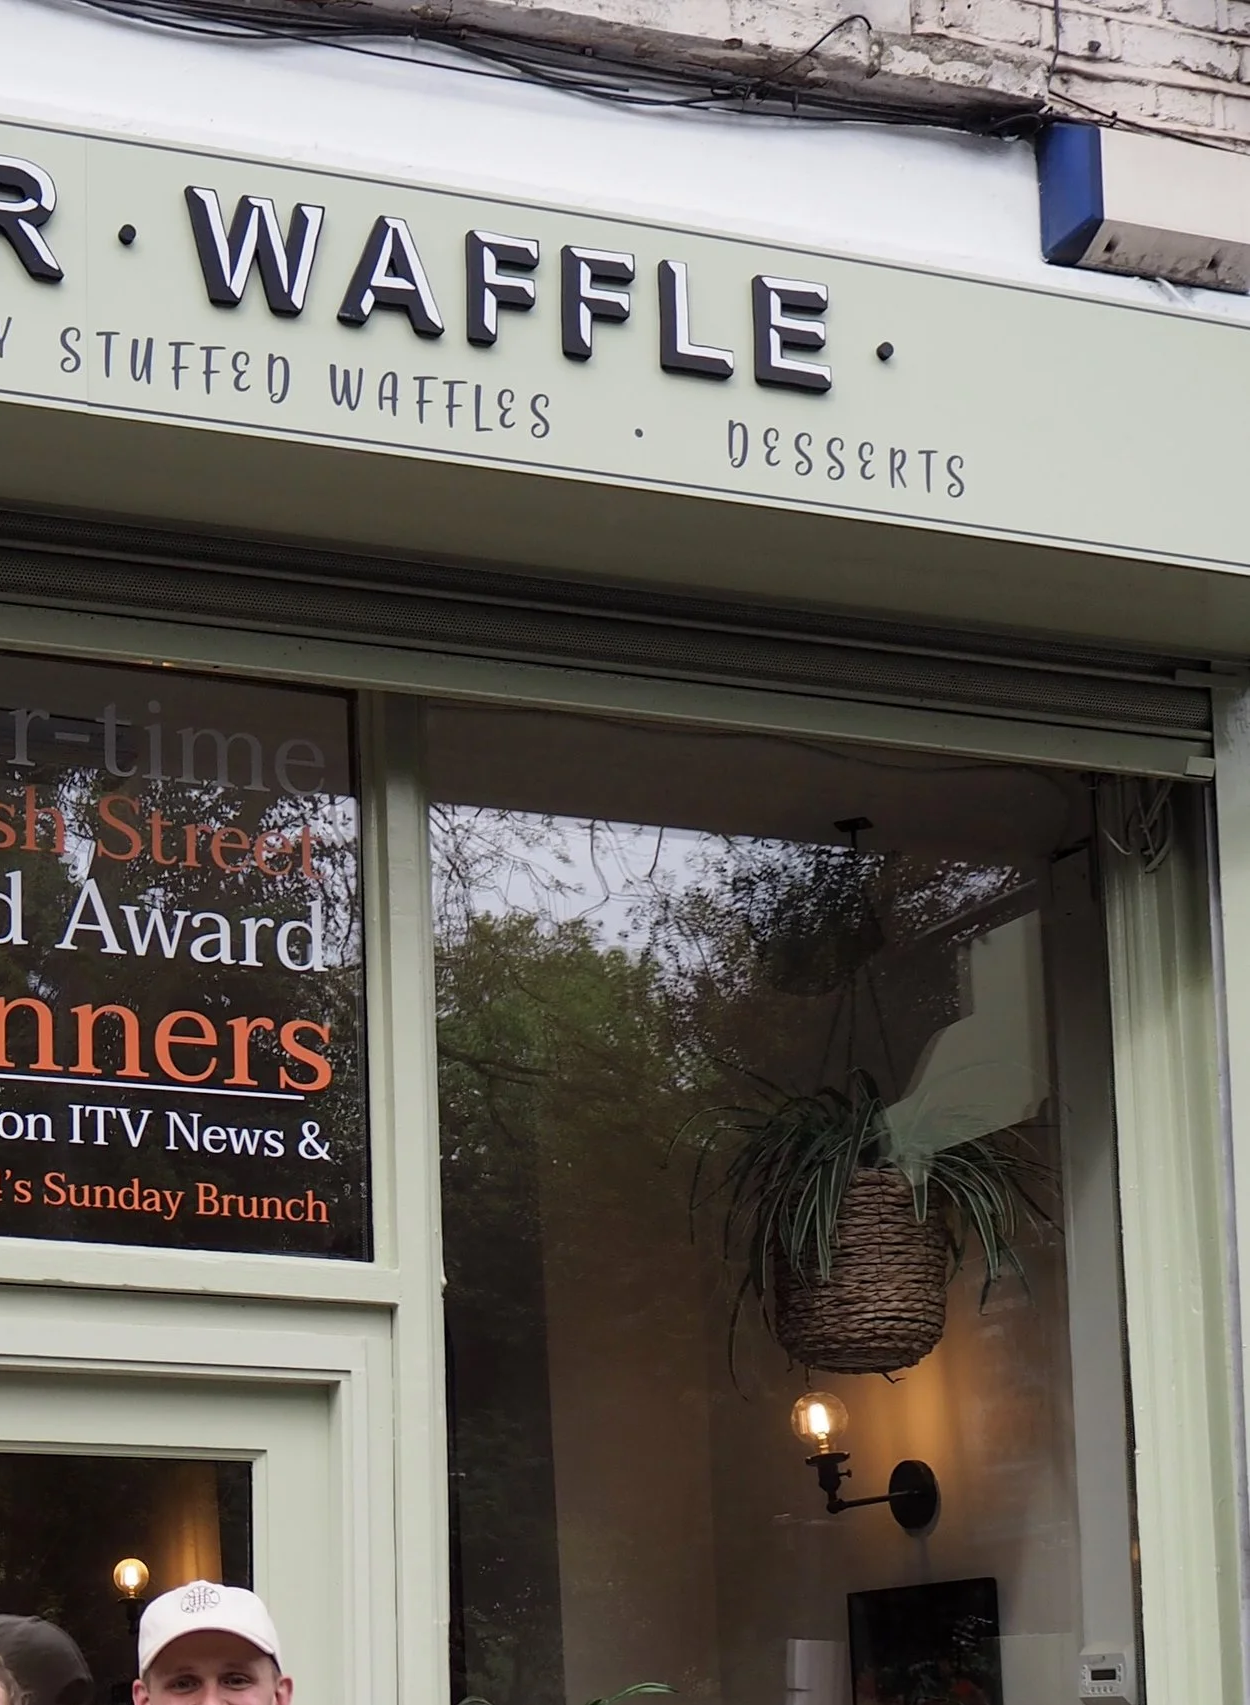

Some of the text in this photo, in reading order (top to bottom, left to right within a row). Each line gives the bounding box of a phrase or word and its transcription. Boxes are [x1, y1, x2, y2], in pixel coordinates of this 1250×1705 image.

[183, 185, 833, 395] WAFFLE
[58, 325, 291, 404] STUFFED
[329, 362, 553, 440] WAFFLES
[726, 418, 967, 500] DESSERTS
[96, 791, 327, 882] Street
[54, 877, 330, 973] Award
[68, 1104, 153, 1149] ITV
[165, 1111, 285, 1157] News
[297, 1121, 331, 1161] &
[42, 1172, 184, 1221] Sunday
[196, 1182, 331, 1224] Brunch
